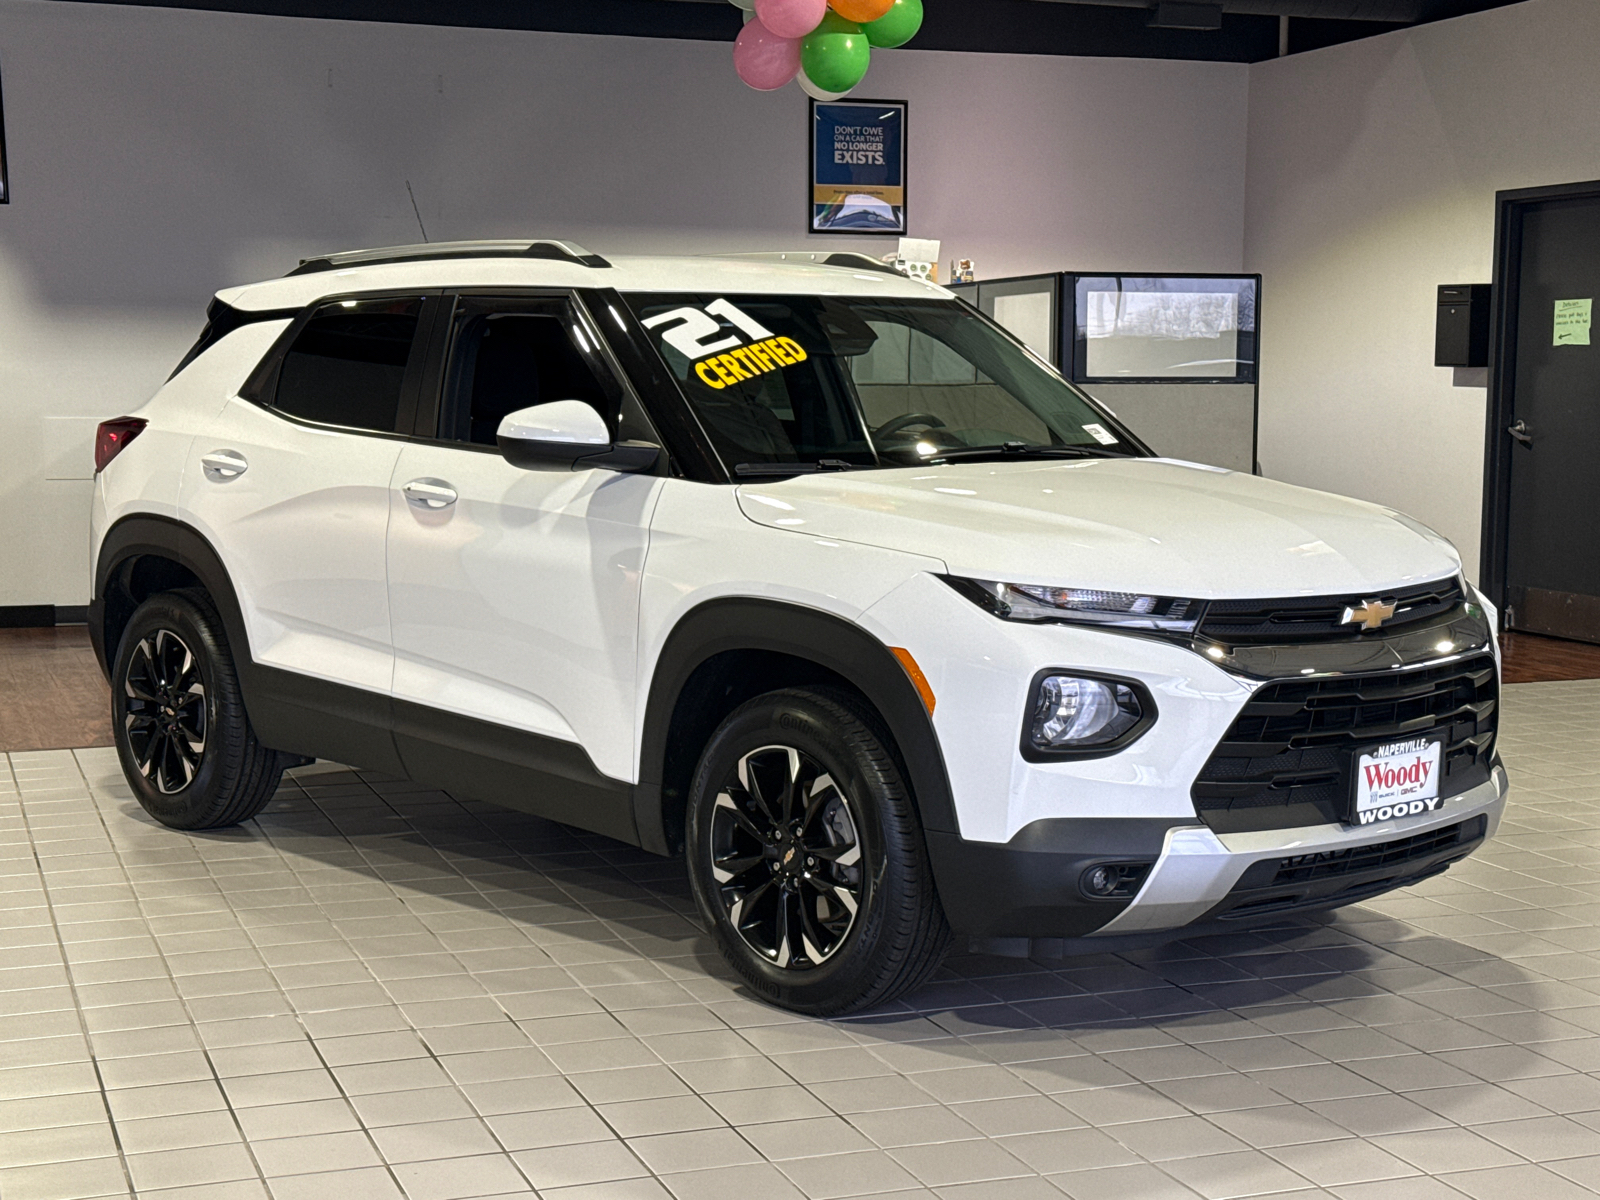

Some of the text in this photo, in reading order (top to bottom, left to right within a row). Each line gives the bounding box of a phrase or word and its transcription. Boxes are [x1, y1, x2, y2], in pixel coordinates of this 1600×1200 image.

[834, 125, 883, 136] DON'T OWE
[834, 142, 883, 151] NO LONGER
[834, 151, 885, 165] EXISTS.
[640, 298, 775, 360] 21
[695, 336, 807, 389] CERTIFIED
[1378, 738, 1426, 758] NAPERVILLE
[1364, 756, 1433, 792] Woody
[1400, 786, 1417, 796] GMC
[1359, 797, 1439, 824] WOODY
